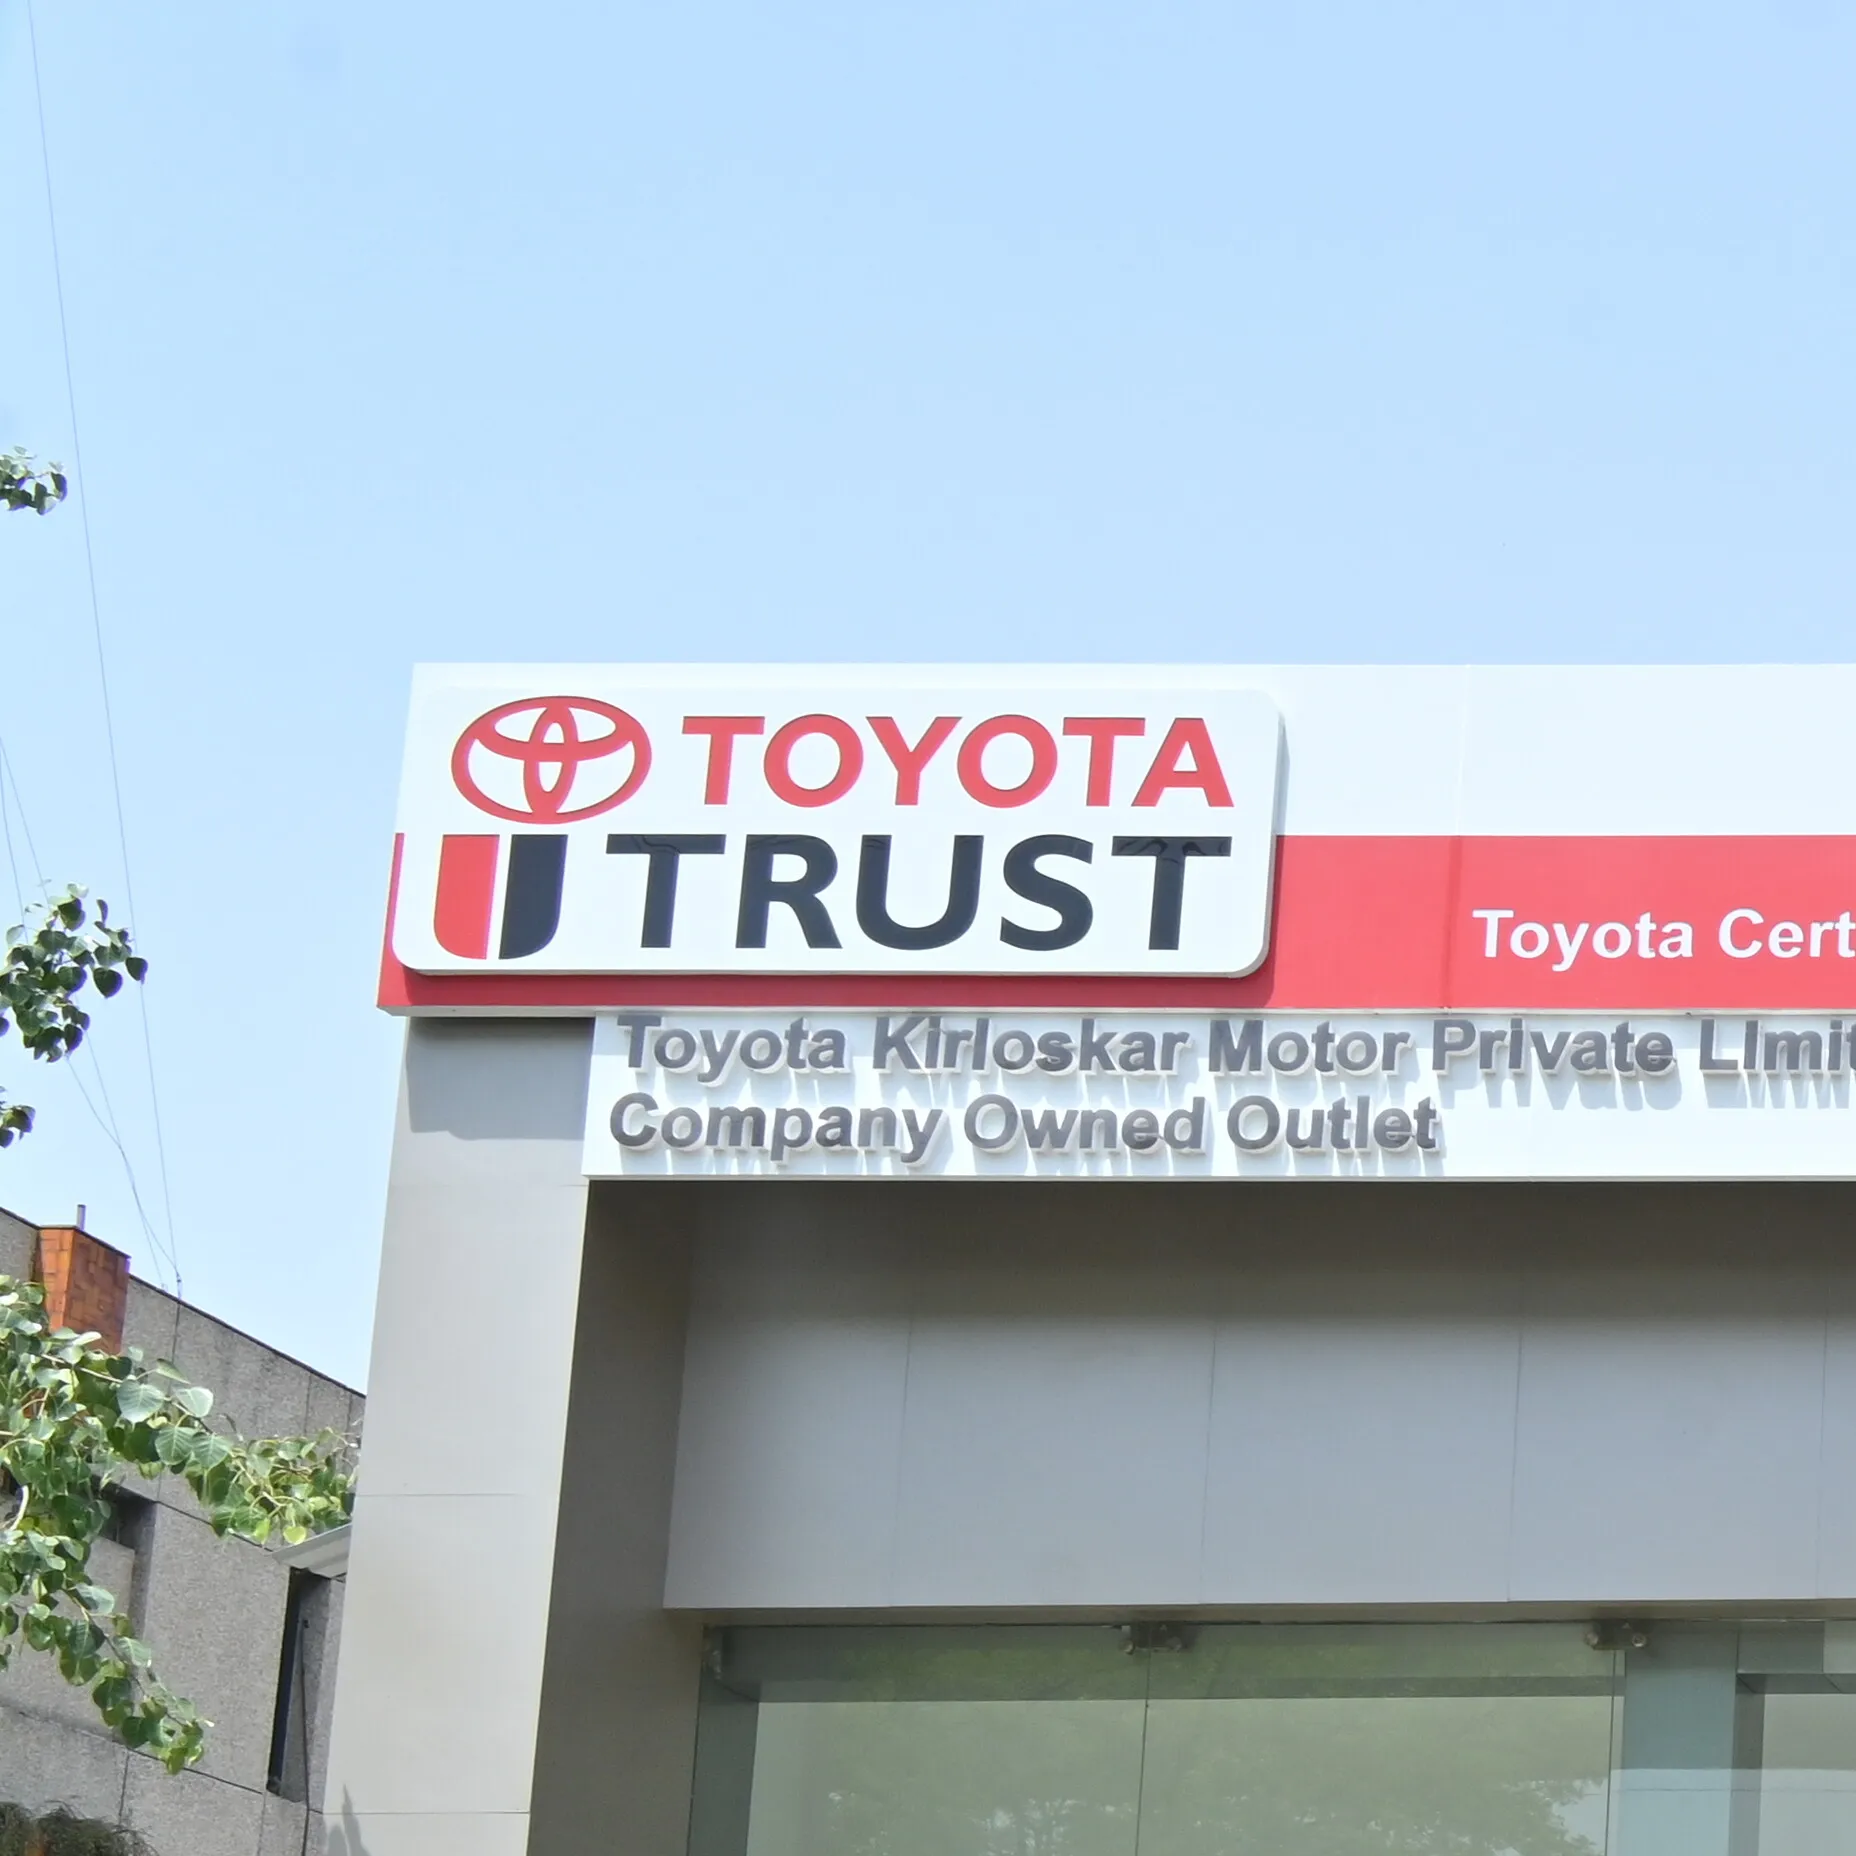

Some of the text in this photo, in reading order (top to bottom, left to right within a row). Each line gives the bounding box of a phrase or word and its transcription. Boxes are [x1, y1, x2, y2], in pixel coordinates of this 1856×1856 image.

[682, 713, 1235, 809] TOYOTA
[605, 833, 1233, 952] TRUST
[1473, 908, 1694, 971] Toyota
[616, 1014, 848, 1084] Toyota
[872, 1015, 1194, 1073] Kirloskar
[1207, 1017, 1410, 1075] Motor
[1432, 1016, 1678, 1075] Private
[609, 1092, 1440, 1164] Company Owned Outlet
